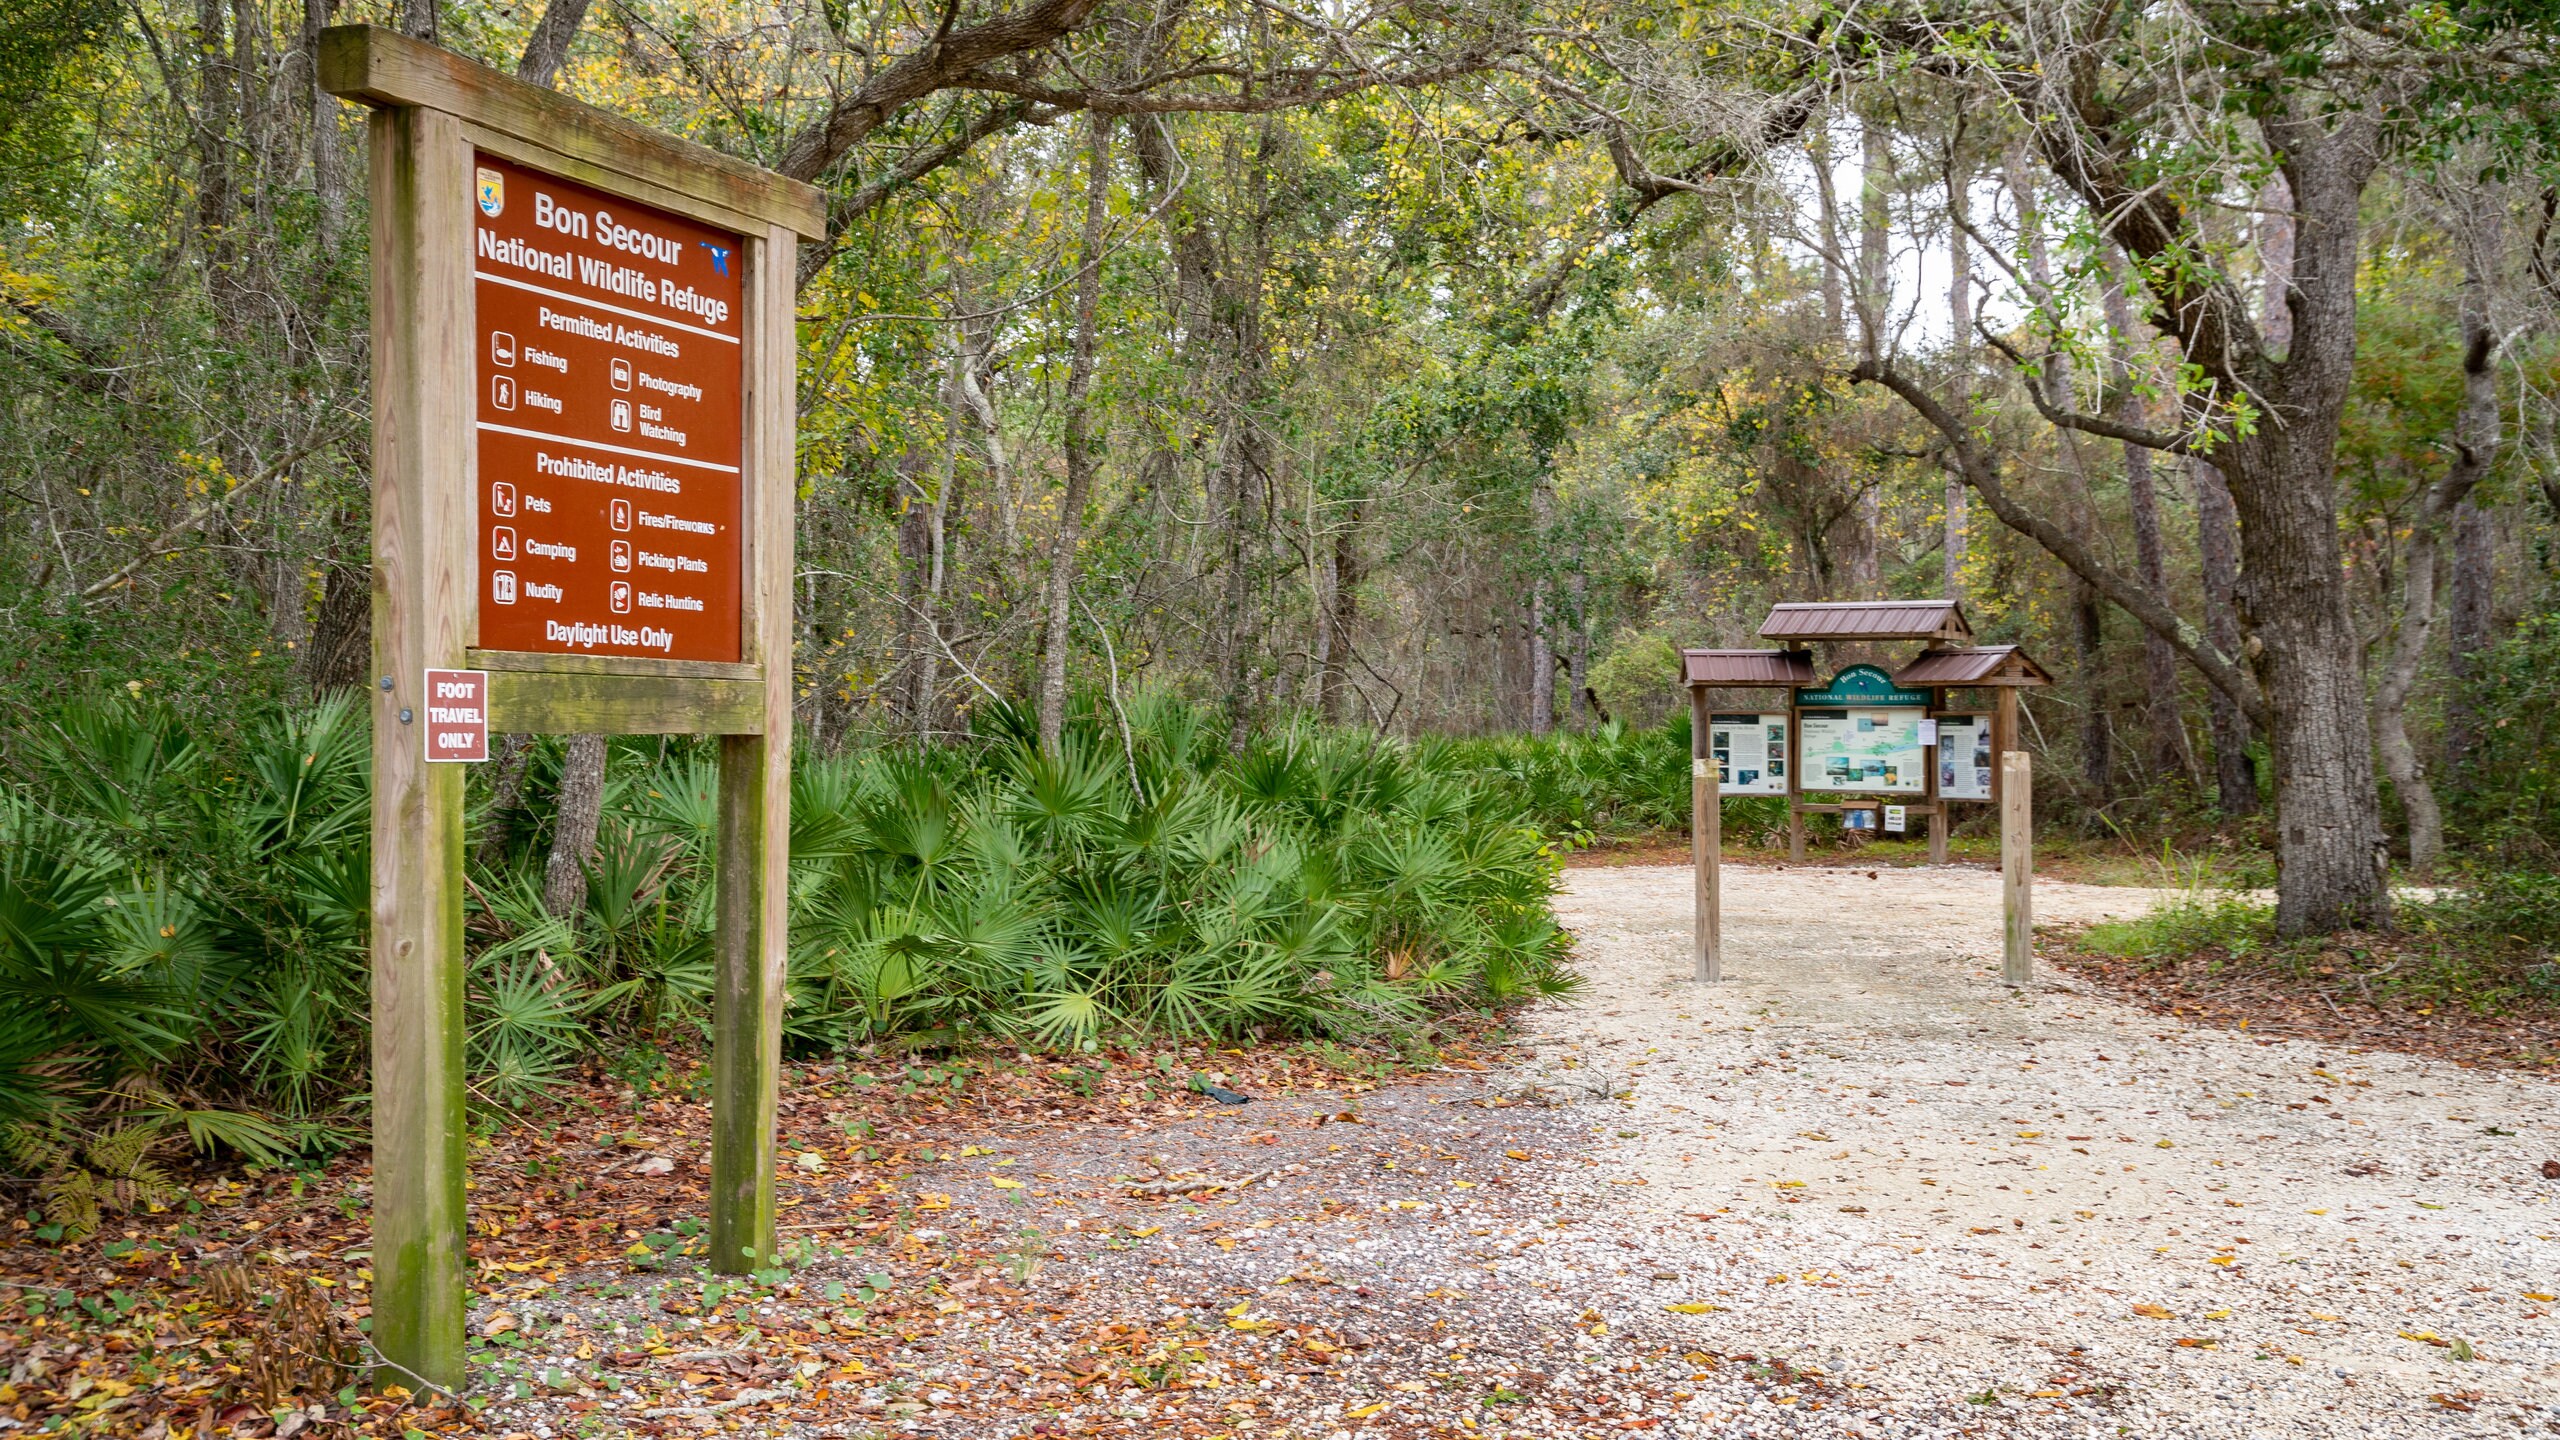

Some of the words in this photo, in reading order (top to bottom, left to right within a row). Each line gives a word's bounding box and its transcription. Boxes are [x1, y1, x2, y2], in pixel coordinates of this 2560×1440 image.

[535, 192, 588, 240] Bon
[595, 211, 682, 266] Secour
[478, 227, 573, 281] National
[578, 254, 656, 303] Wildlife
[660, 278, 728, 325] Refuge
[539, 306, 613, 342] Permitted
[614, 324, 680, 358] Activities
[524, 346, 568, 374] Fishing
[638, 371, 702, 402] Photography
[525, 389, 562, 414] Hiking
[639, 403, 662, 422] Bird
[639, 421, 686, 447] Watching
[537, 451, 614, 484] Prohibited
[616, 465, 681, 495] Activities
[525, 495, 552, 513] Pets
[525, 538, 577, 562] Camping
[638, 551, 676, 573] Picking
[677, 555, 708, 573] Plants
[525, 581, 563, 603] Nudity
[638, 591, 665, 608] Relic
[546, 620, 608, 649] Daylight
[610, 624, 639, 646] Use
[640, 626, 673, 652] Only
[1840, 672, 1857, 684] Bon
[1858, 668, 1887, 684] Secour
[437, 682, 476, 699] FOOT
[429, 707, 483, 724] TRAVEL
[438, 732, 476, 749] ONLY
